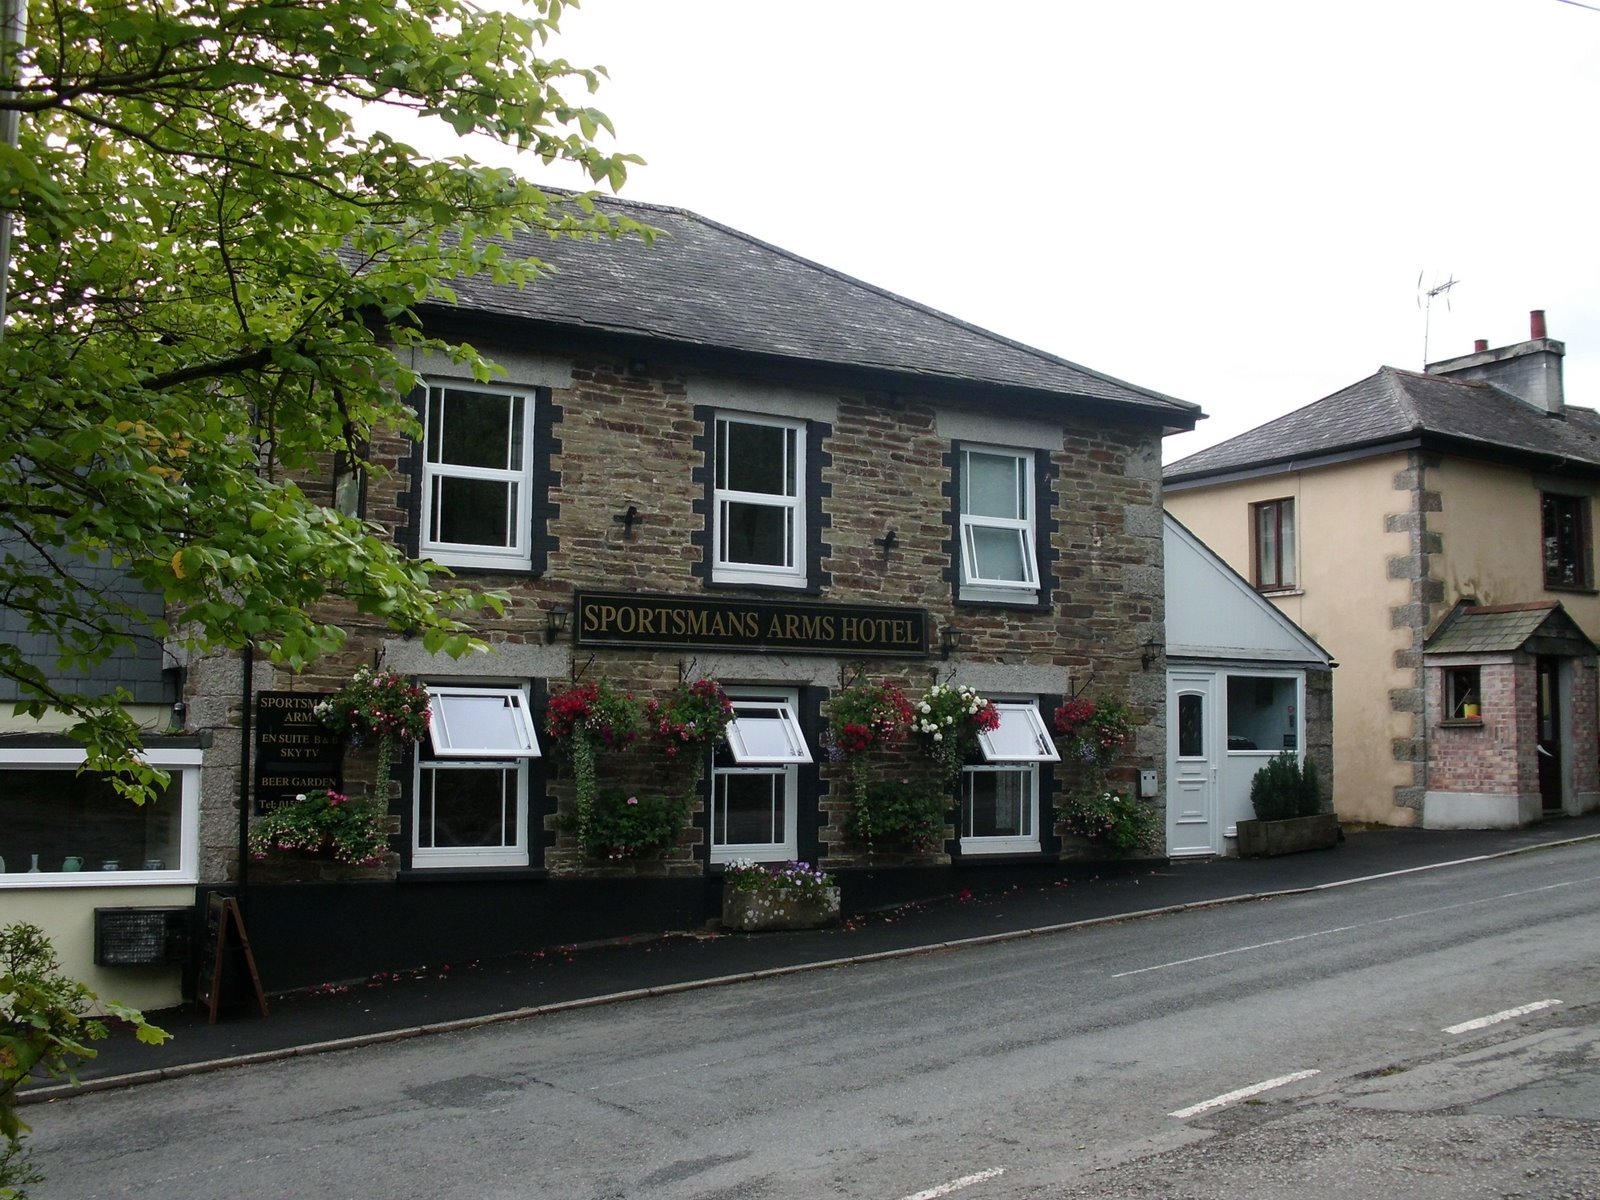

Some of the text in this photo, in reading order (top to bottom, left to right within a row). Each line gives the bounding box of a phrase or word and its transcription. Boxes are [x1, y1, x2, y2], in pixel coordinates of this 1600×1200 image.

[583, 604, 920, 644] SPORTSMANS ARMS HOTEL
[260, 697, 319, 709] SPORTSM
[284, 712, 315, 723] ARM
[280, 748, 320, 758] SKY TV
[261, 777, 337, 787] BEER GARDEN
